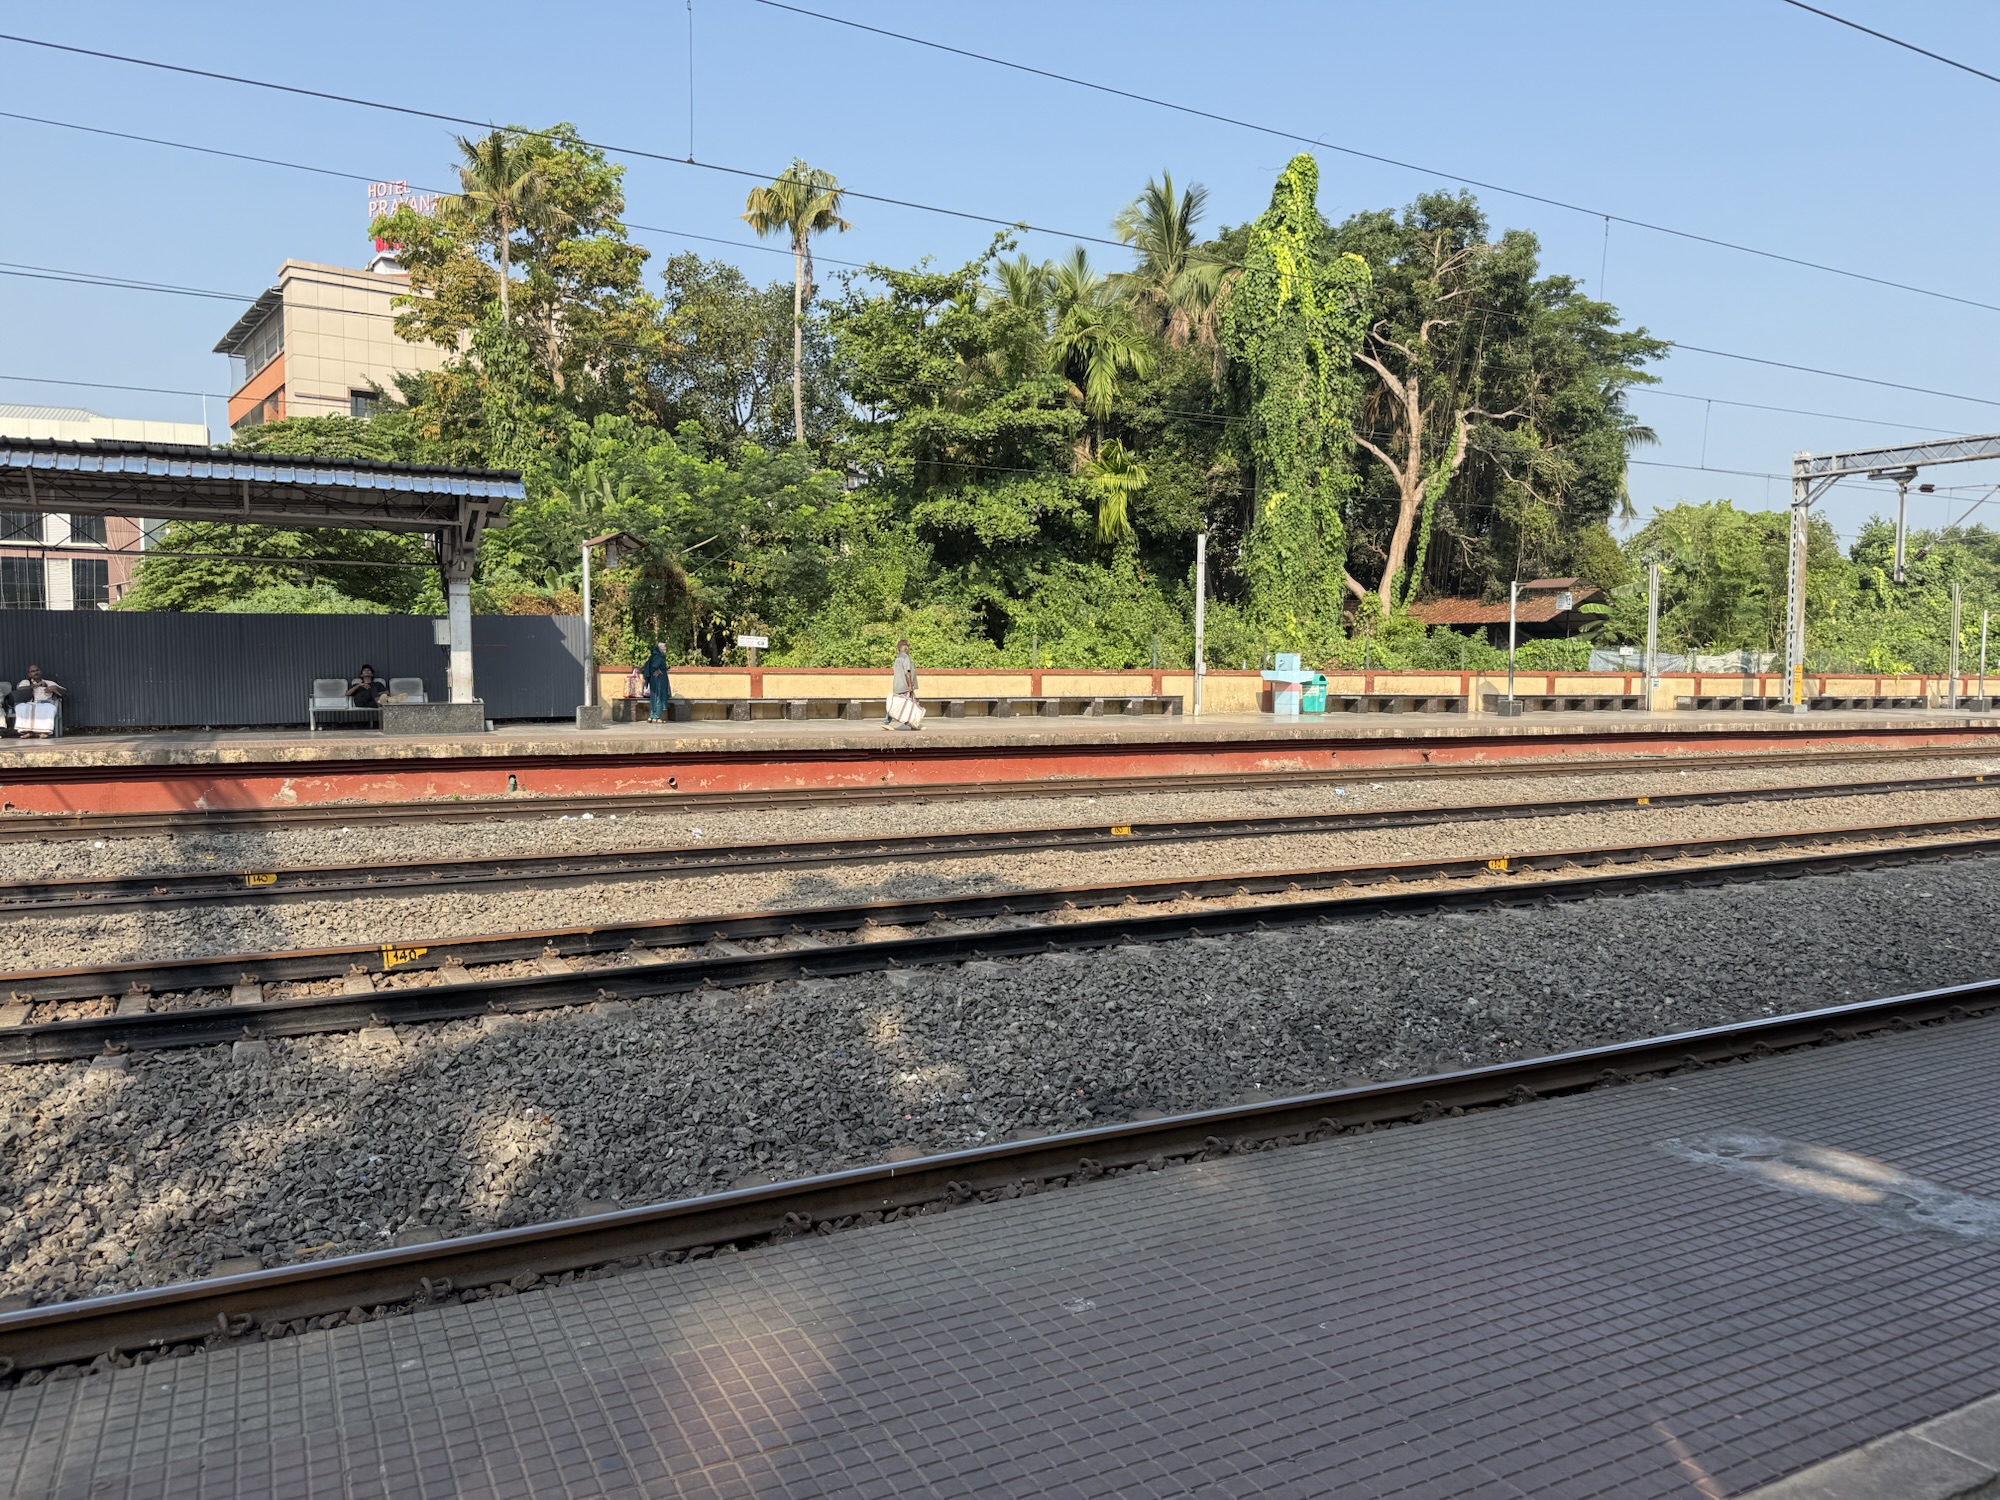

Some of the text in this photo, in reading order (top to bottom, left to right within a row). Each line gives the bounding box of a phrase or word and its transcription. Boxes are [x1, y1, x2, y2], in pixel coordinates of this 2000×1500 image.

[367, 179, 412, 198] HOTEL
[253, 874, 268, 883] 140
[394, 948, 417, 962] 140
